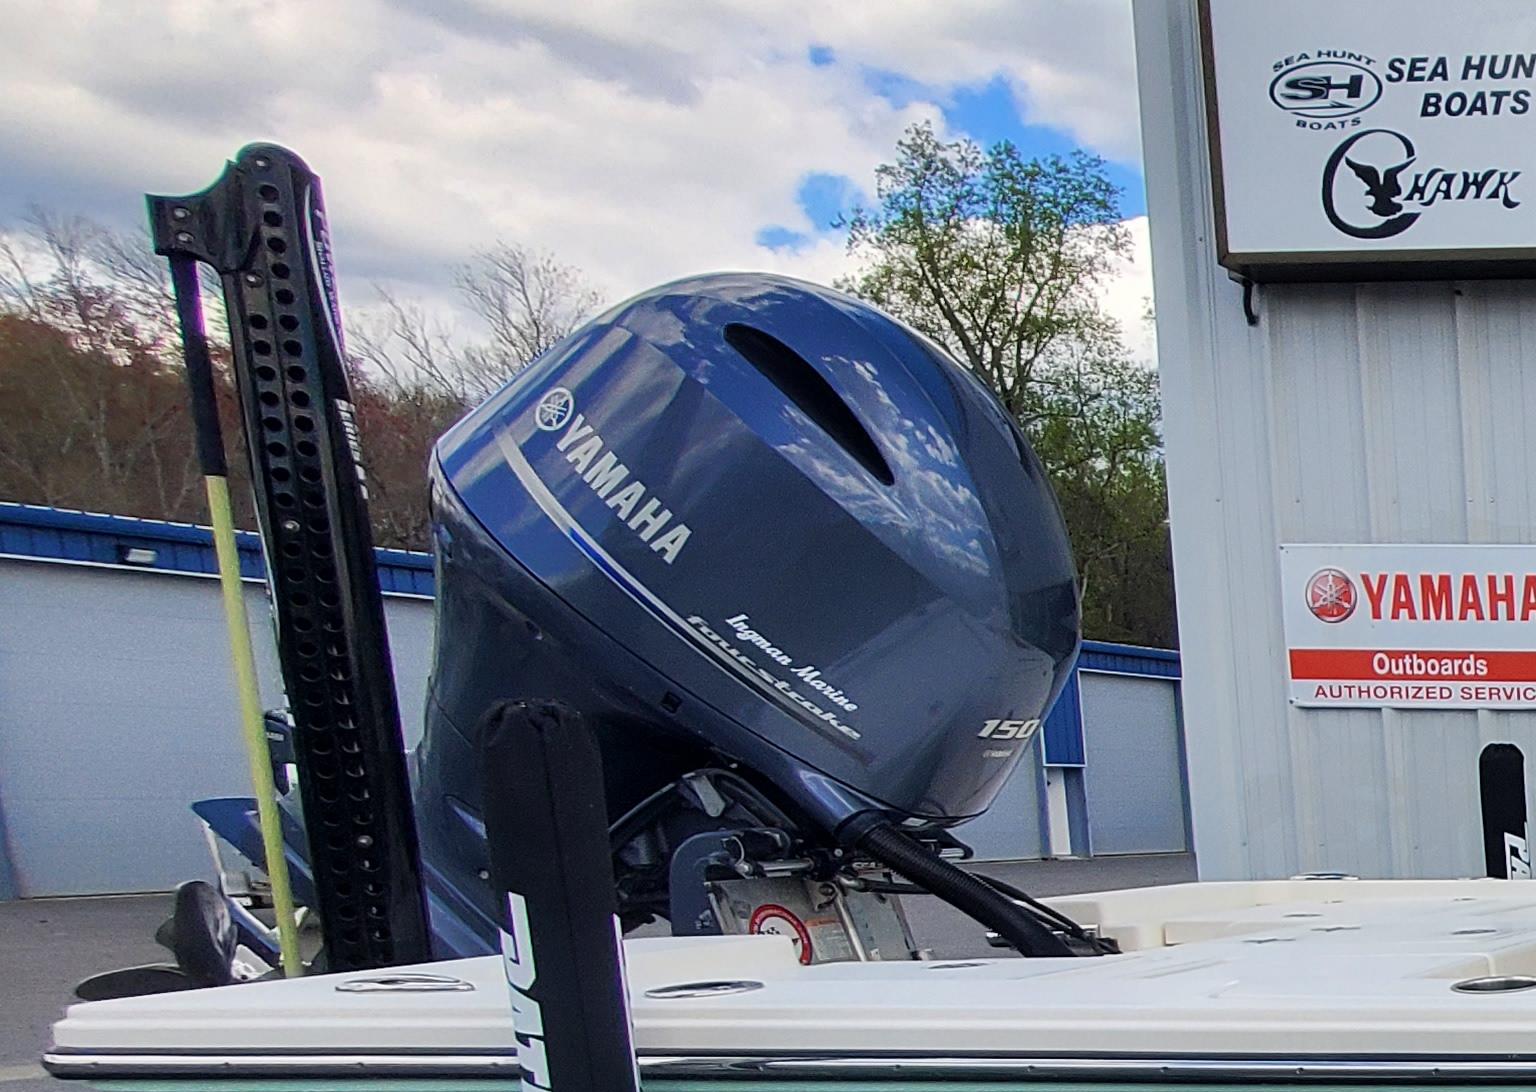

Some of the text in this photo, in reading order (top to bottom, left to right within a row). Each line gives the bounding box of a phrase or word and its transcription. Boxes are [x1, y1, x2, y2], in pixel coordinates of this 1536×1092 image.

[1273, 50, 1376, 72] SEA HUNT
[1385, 57, 1449, 83] SEA
[1280, 74, 1363, 100] SH
[1420, 90, 1532, 118] BOATS
[1296, 117, 1361, 131] BOATS
[556, 413, 692, 565] YAMAHA
[725, 614, 859, 712] Ingman Marine
[1372, 652, 1489, 676] Outboards
[1314, 685, 1453, 700] AUTHORIZED
[977, 719, 1041, 739] 150
